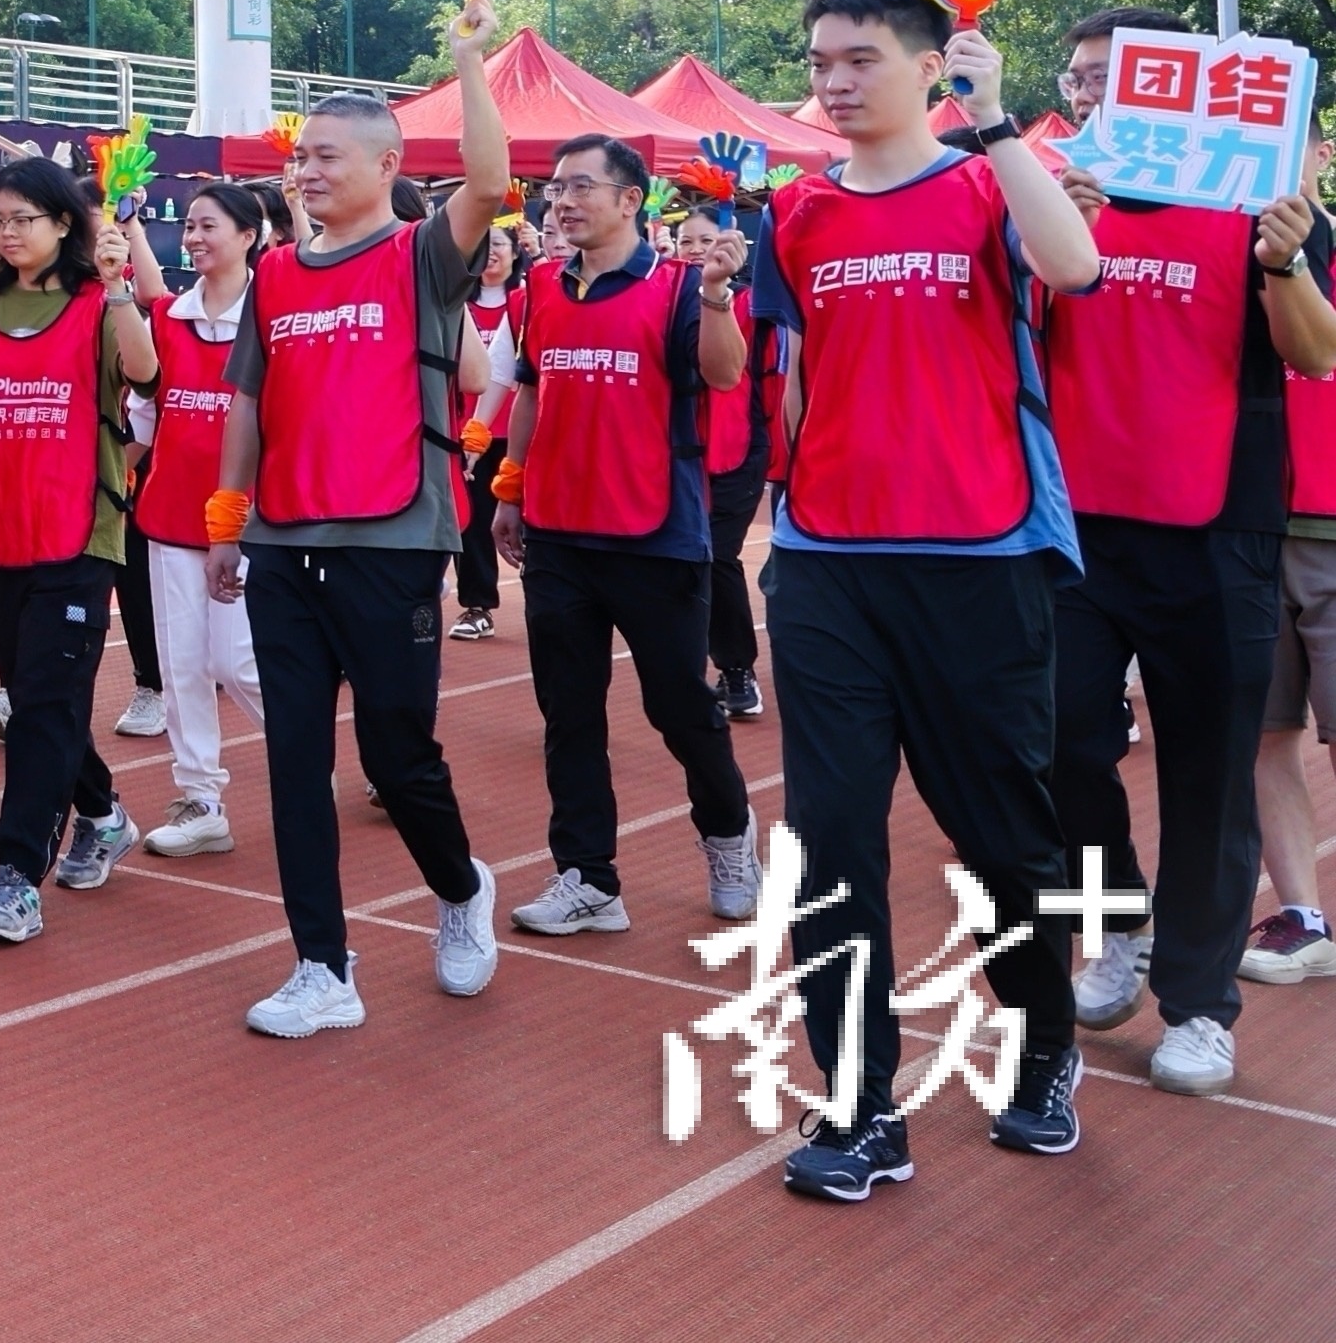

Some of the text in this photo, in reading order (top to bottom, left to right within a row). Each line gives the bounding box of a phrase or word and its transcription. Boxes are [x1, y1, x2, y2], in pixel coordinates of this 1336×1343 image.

[1115, 44, 1292, 127] 团结
[1112, 116, 1281, 202] 努力
[940, 256, 968, 268] 团建
[940, 267, 968, 281] 定制
